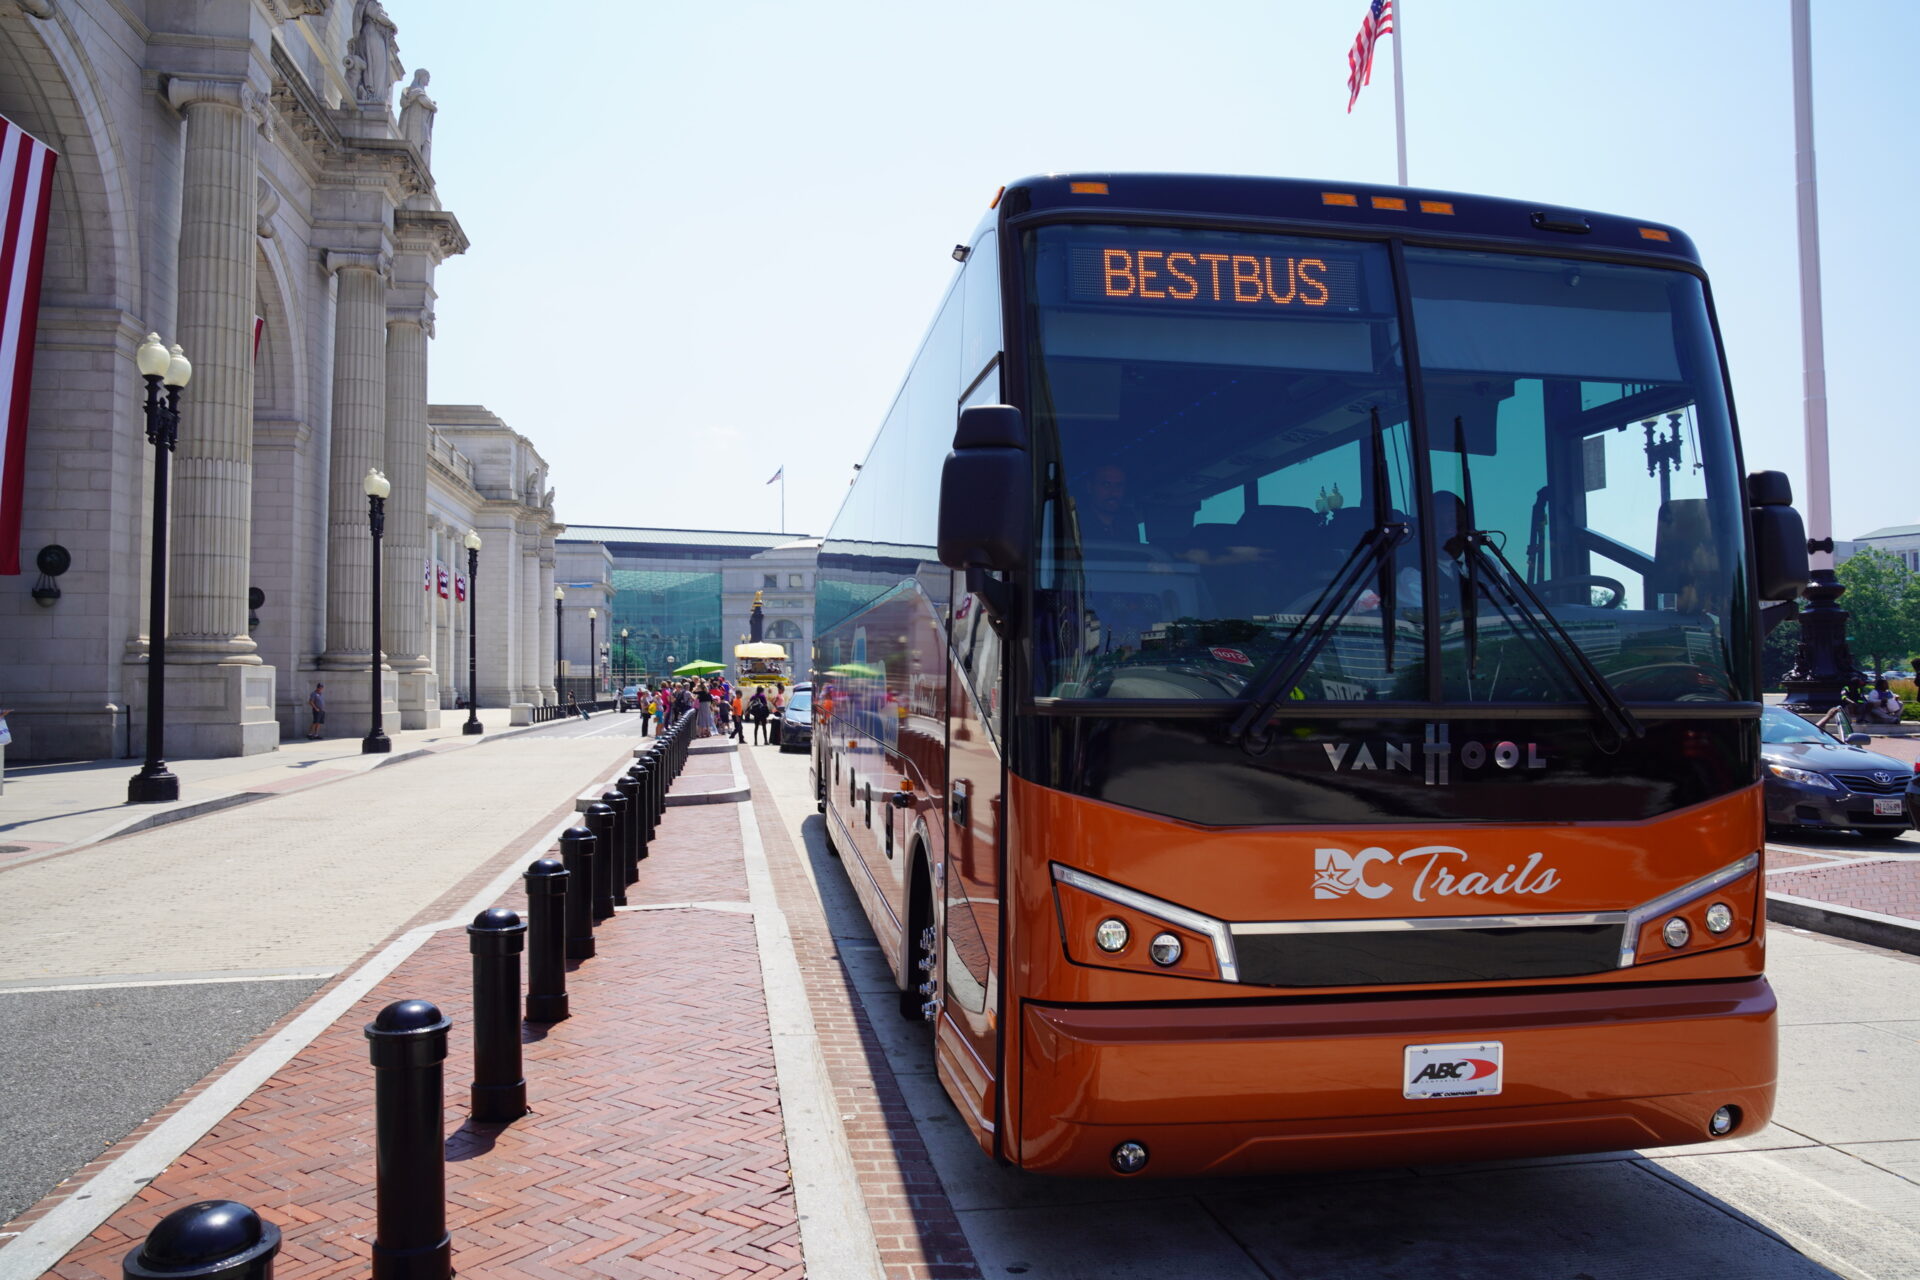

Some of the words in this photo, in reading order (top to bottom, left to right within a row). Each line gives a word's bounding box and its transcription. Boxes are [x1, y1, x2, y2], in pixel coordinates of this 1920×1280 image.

[1104, 249, 1329, 306] BESTBUS
[1397, 845, 1562, 902] Trails
[1411, 1061, 1469, 1084] ABC
